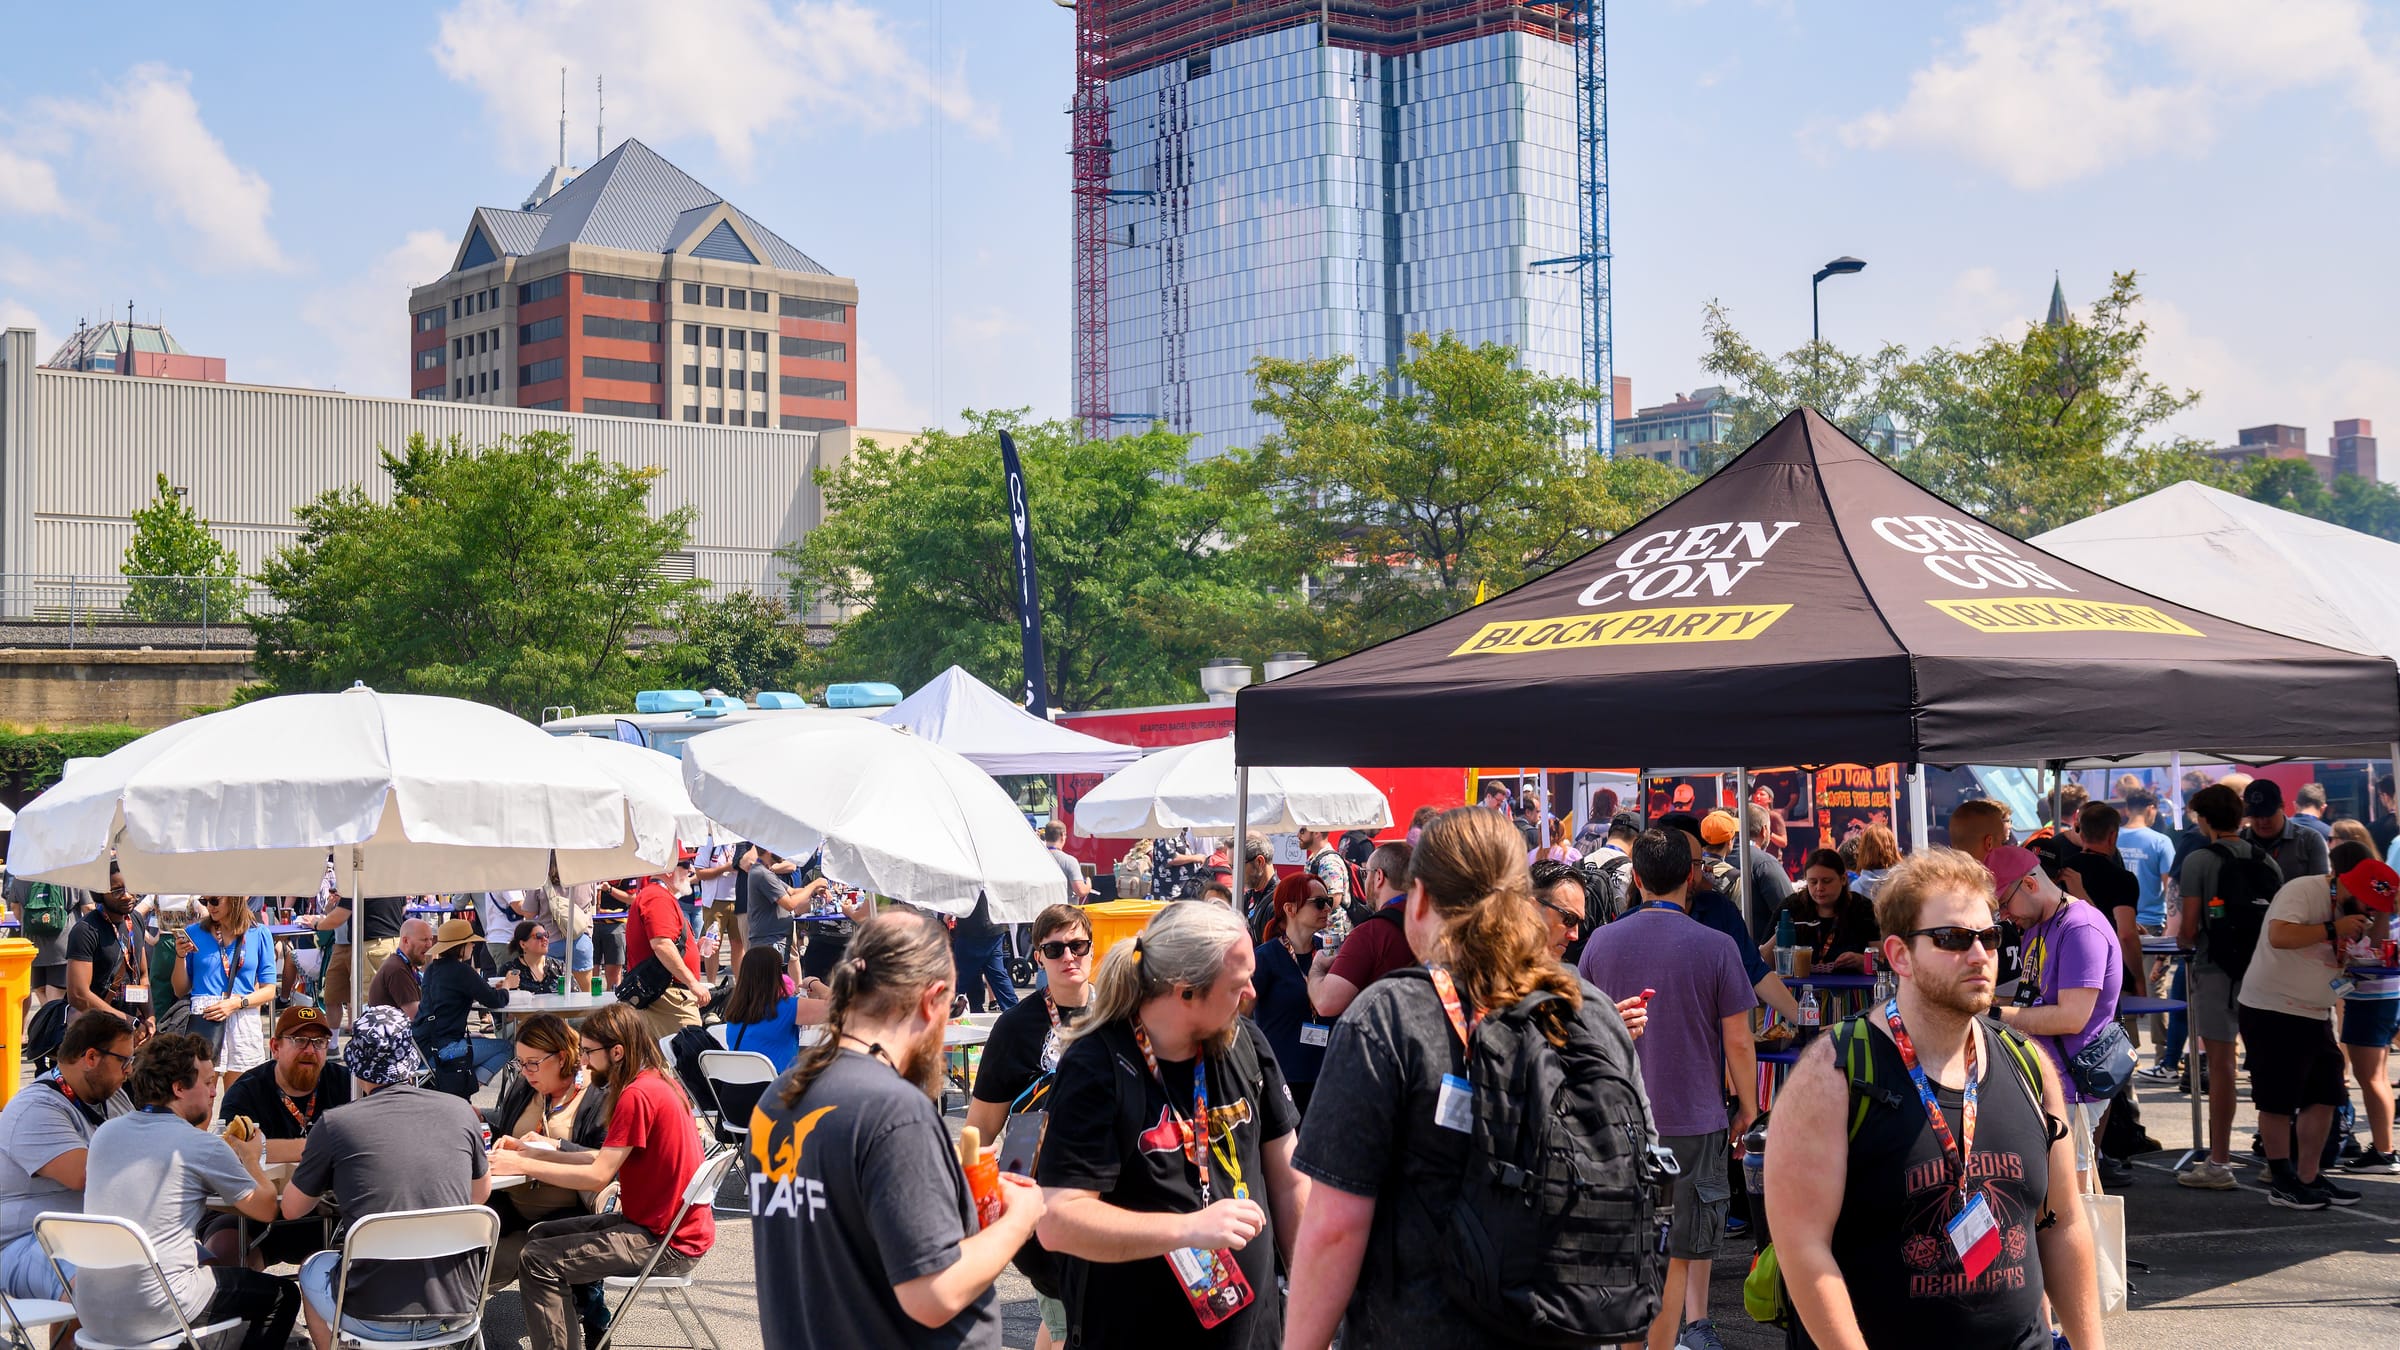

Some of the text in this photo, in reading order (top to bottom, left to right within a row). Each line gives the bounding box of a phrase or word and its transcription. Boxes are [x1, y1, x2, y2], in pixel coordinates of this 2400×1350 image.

[1616, 522, 1800, 569] GEN
[1871, 516, 2021, 559] GEN
[1578, 561, 1764, 606] CON
[1923, 554, 2079, 593] CON
[1471, 611, 1775, 651] BLOCK PARTY
[1948, 603, 2181, 631] BLOCK PARTY
[1140, 723, 1167, 732] BEARDED
[1827, 791, 1900, 807] ASTE THE HEA
[1907, 1152, 2023, 1194] DUNEONS
[750, 1172, 827, 1223] TAFF
